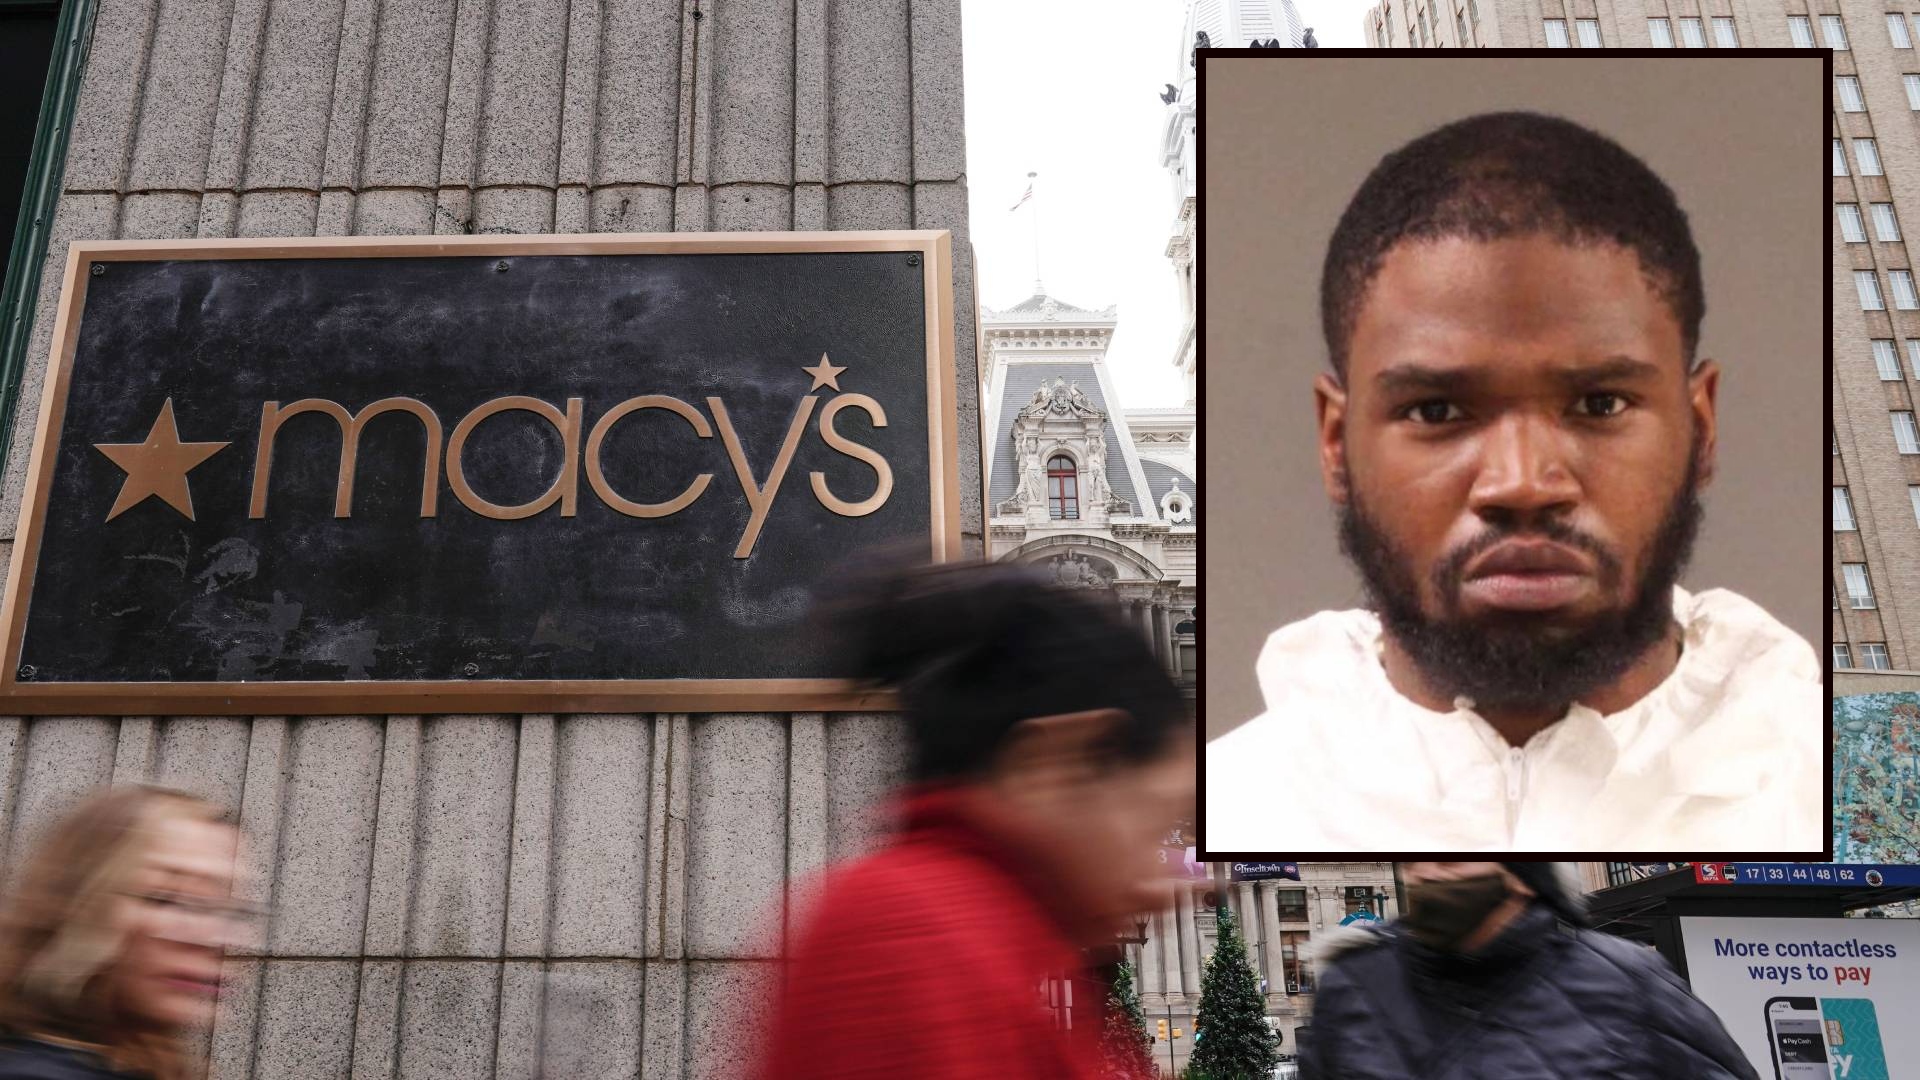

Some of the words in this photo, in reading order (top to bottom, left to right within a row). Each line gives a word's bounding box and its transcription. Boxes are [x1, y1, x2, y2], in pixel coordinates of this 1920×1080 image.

[1234, 863, 1280, 873] Tinseltown
[1745, 868, 1759, 879] 17
[1769, 869, 1783, 879] 33
[1793, 869, 1807, 880] 44
[1816, 869, 1831, 880] 48
[1840, 870, 1855, 880] 62
[1714, 938, 1769, 957] More
[1775, 939, 1897, 958] contactless
[1748, 965, 1802, 985] ways
[1807, 963, 1828, 980] to
[1834, 966, 1871, 985] pay
